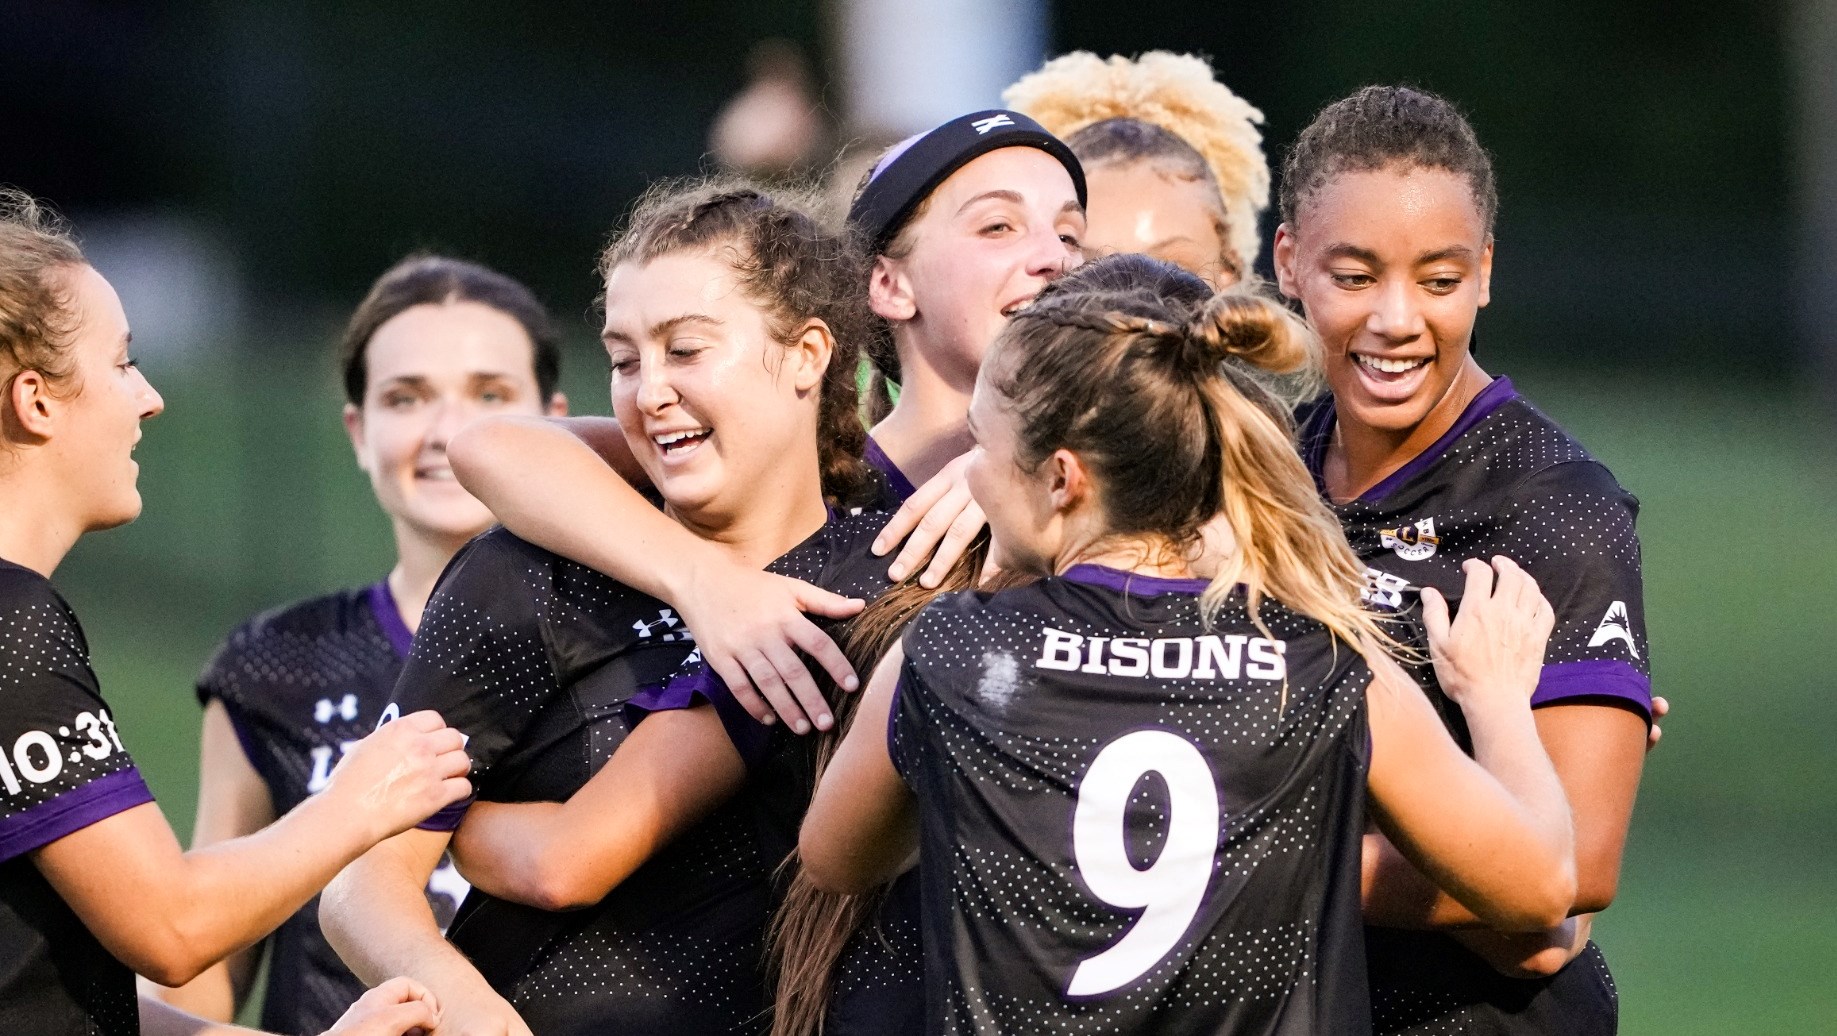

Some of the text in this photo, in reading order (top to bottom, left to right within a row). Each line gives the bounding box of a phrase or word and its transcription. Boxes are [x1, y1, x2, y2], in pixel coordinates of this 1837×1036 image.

[1391, 542, 1429, 556] SOCCER
[1036, 627, 1286, 680] BISONS
[1067, 730, 1219, 996] 9
